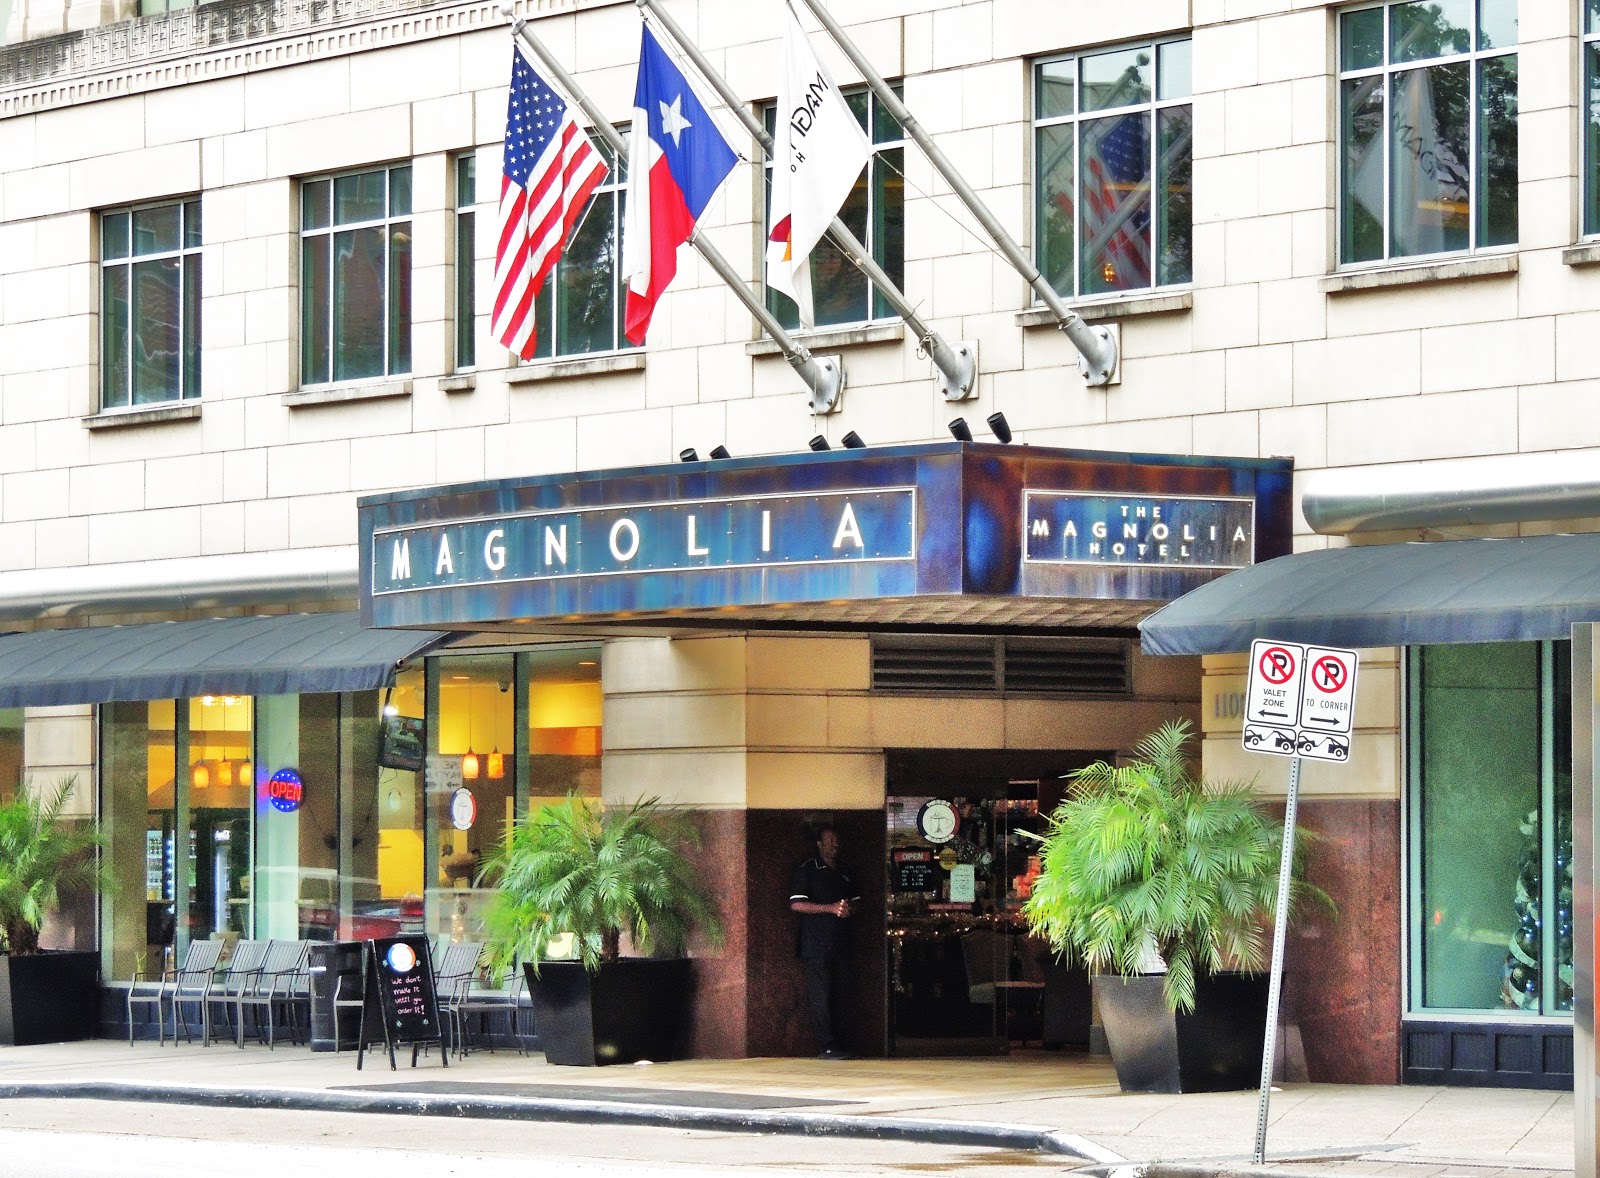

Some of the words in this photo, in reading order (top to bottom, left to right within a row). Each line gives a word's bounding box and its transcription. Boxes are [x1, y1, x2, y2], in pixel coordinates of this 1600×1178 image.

[1120, 505, 1161, 518] THE
[1032, 519, 1246, 542] MAGNOLIA
[391, 502, 865, 580] MAGNOLIA
[1089, 542, 1190, 557] HOTEL
[1263, 688, 1287, 697] VALET
[1263, 698, 1285, 708] ZONE
[1306, 698, 1315, 707] TO
[1320, 700, 1348, 711] CORNER
[270, 780, 302, 801] OPEN
[901, 852, 924, 861] OPEN
[405, 975, 421, 984] don't
[393, 987, 411, 995] make
[395, 996, 410, 1004] until
[397, 1007, 413, 1015] order
[414, 1004, 425, 1015] it!
